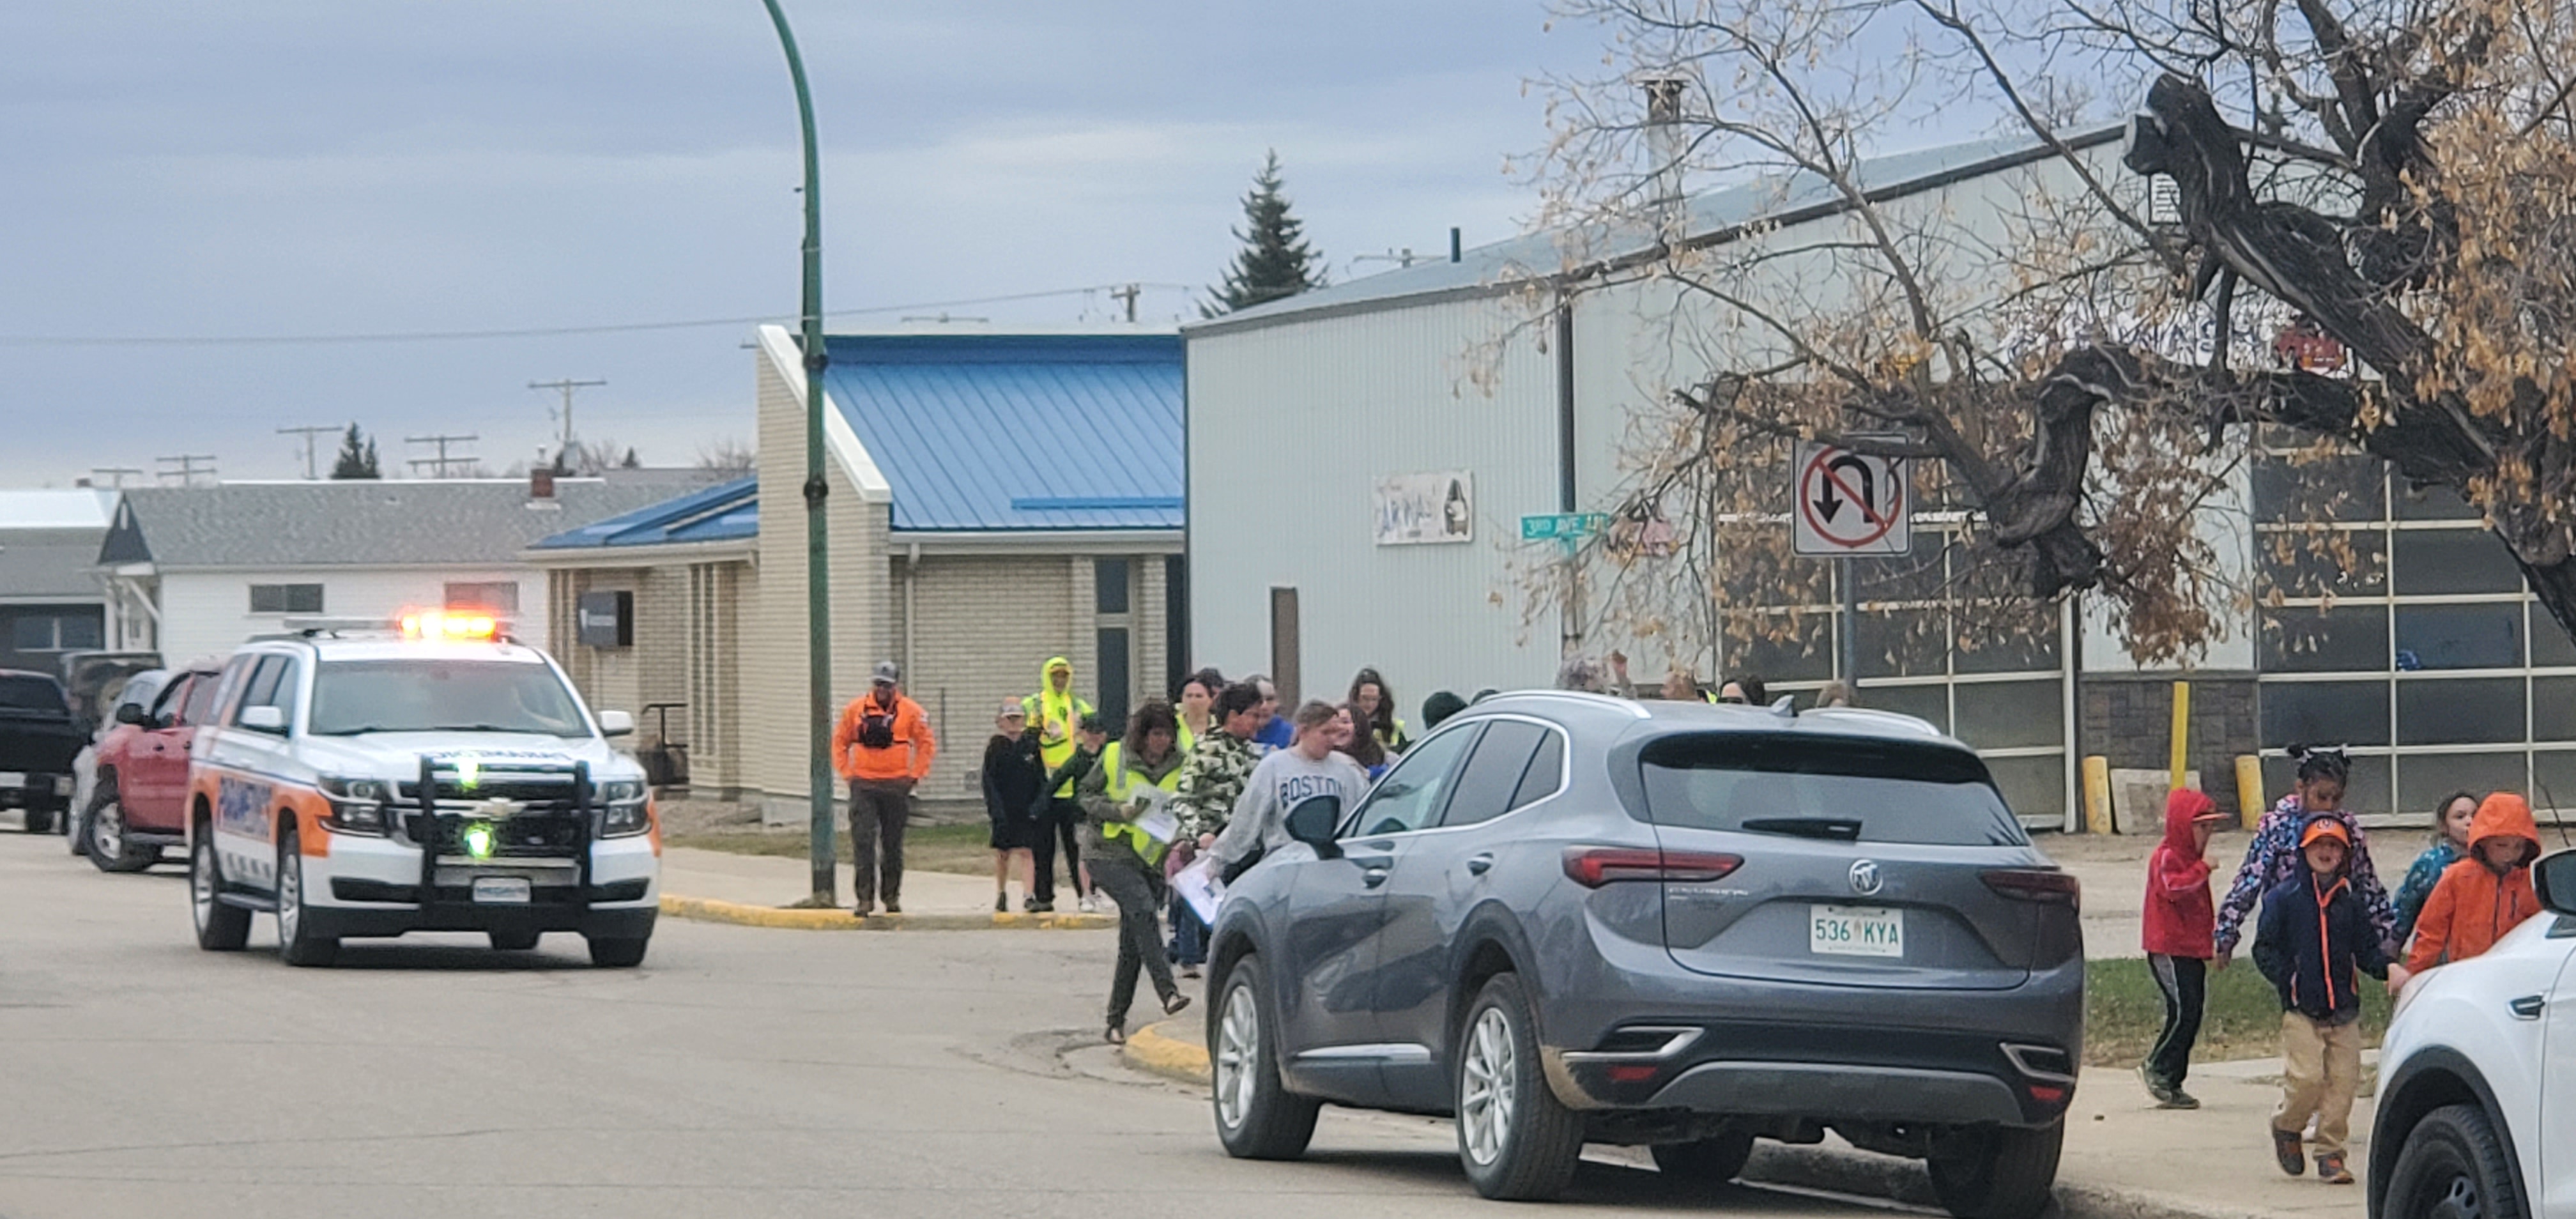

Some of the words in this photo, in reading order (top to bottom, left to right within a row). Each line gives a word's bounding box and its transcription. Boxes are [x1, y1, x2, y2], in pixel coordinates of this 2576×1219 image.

[1526, 518, 1552, 536] 3RD
[1554, 517, 1584, 535] AVE
[1815, 918, 1851, 942] 536
[1864, 921, 1899, 946] KYA
